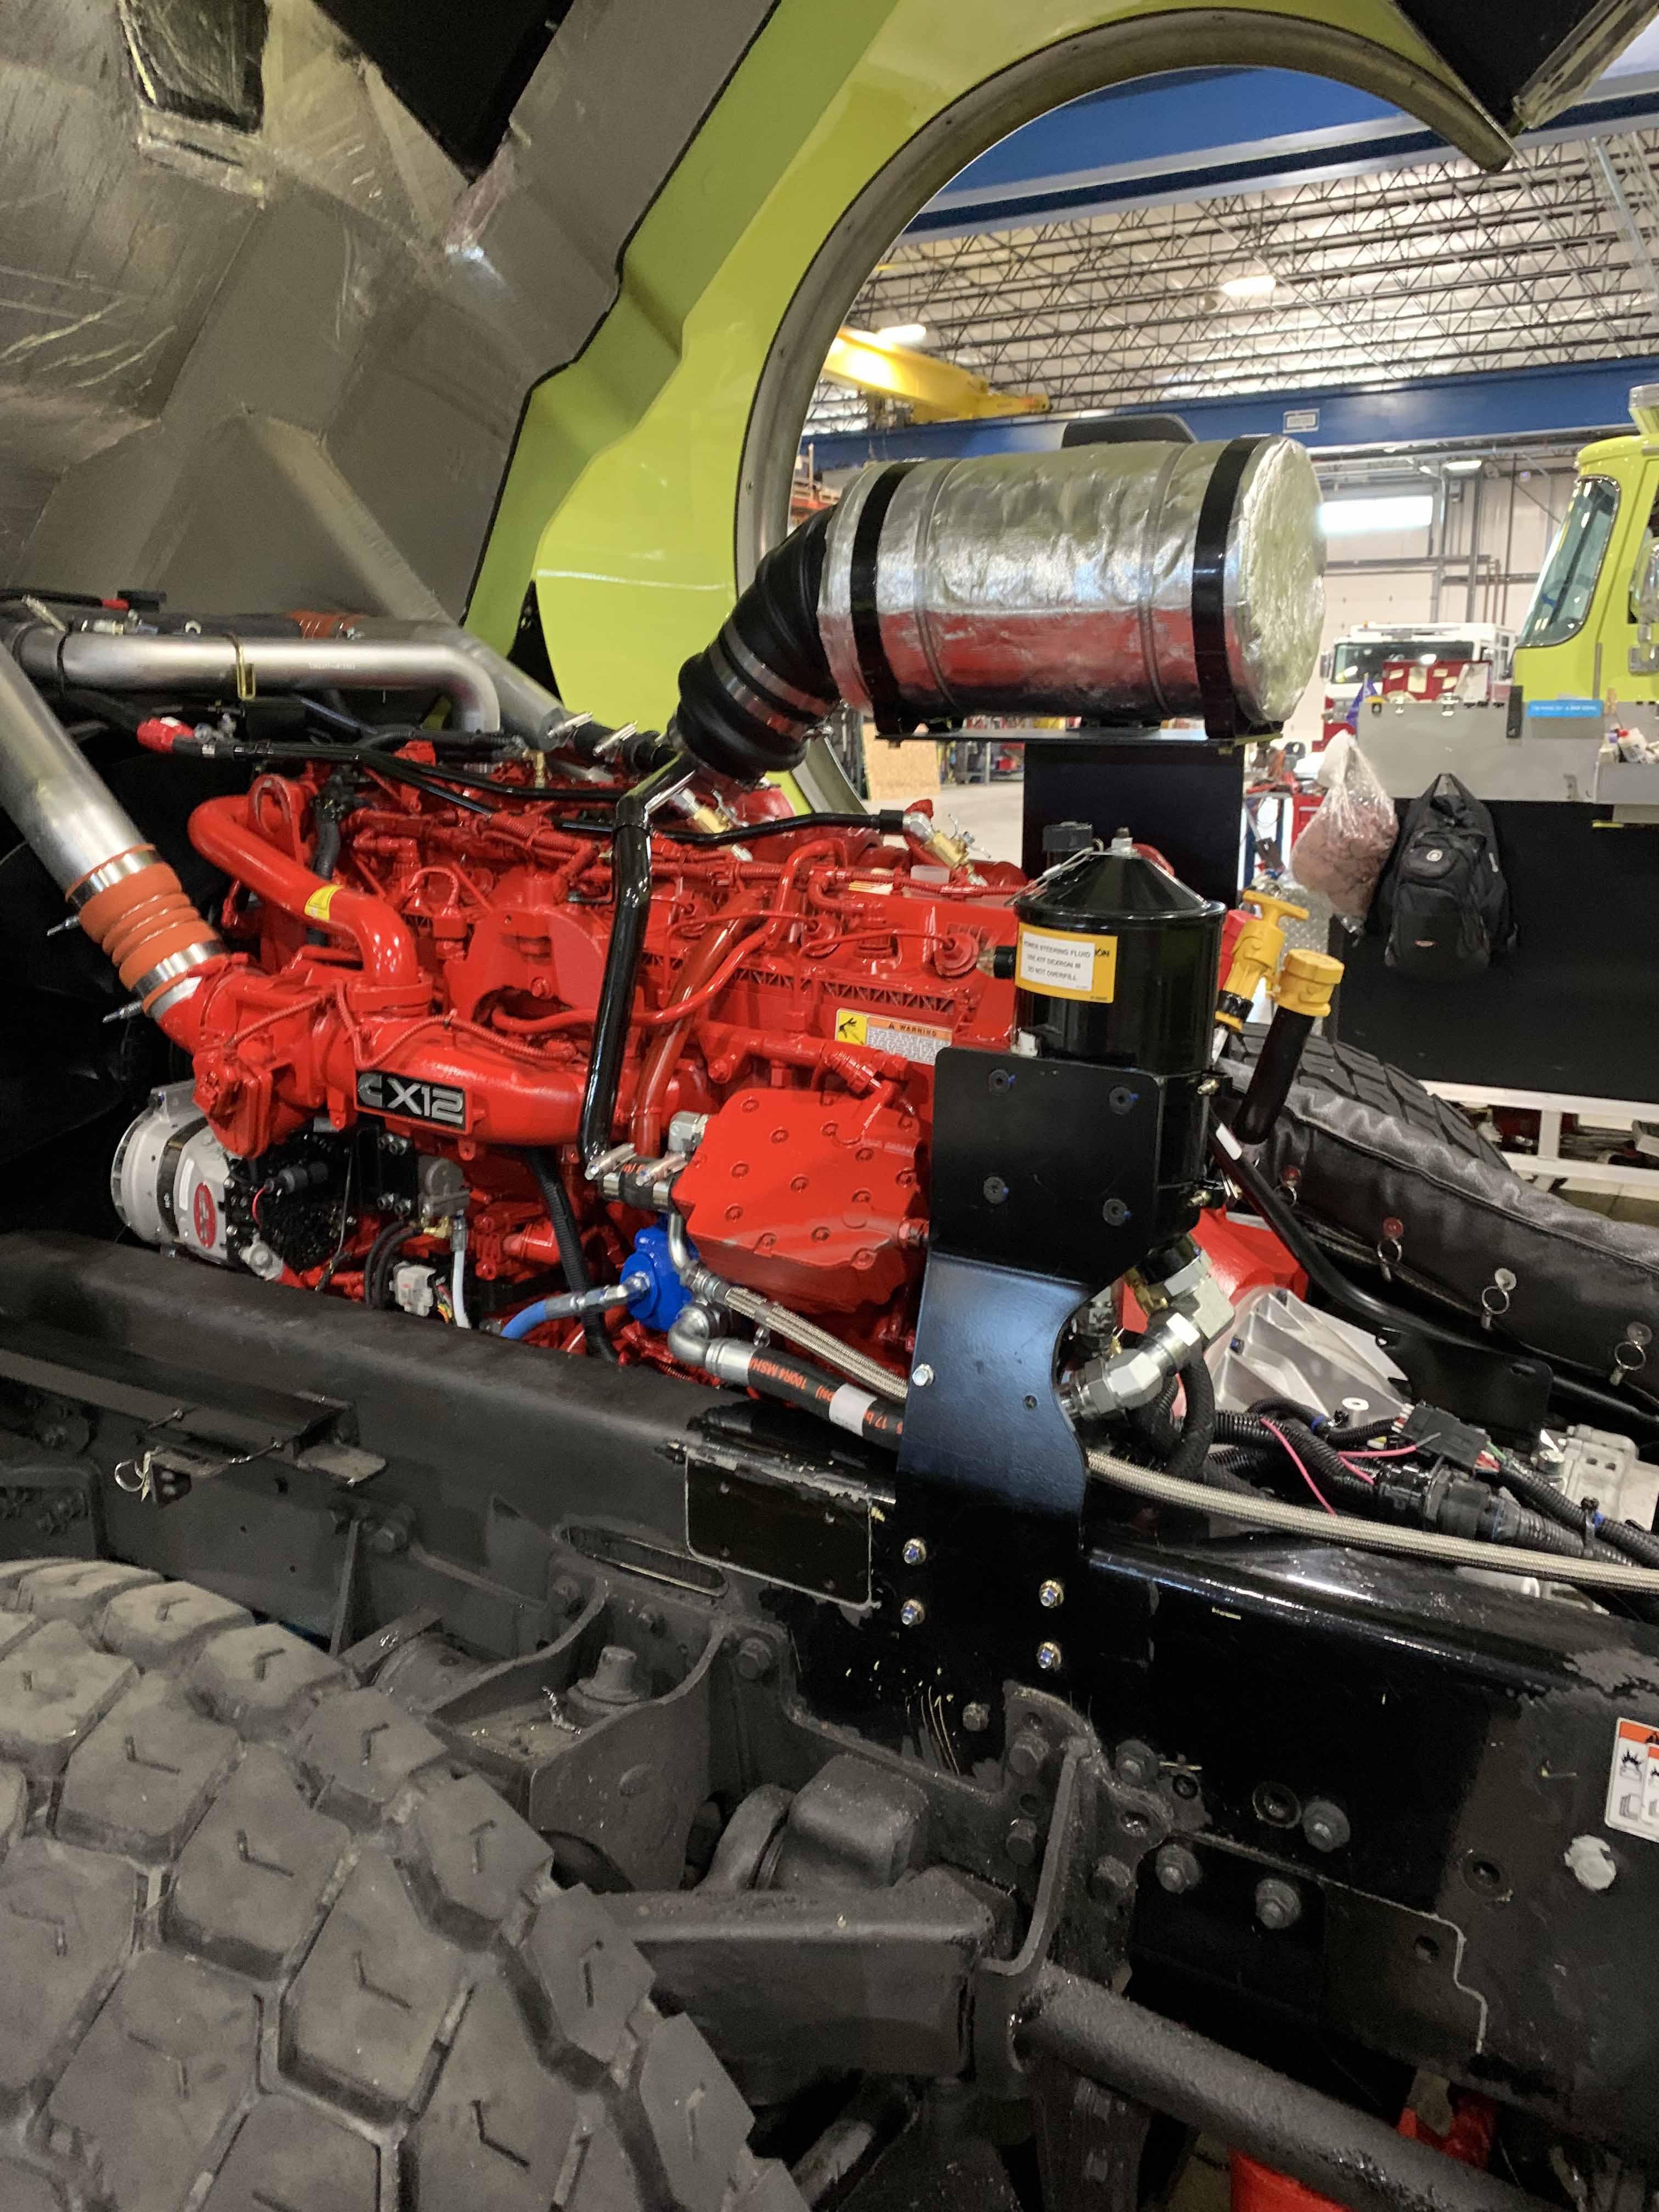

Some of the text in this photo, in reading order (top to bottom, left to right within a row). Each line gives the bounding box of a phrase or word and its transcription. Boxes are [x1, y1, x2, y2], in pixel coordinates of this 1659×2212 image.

[1040, 944, 1069, 956] STEERING
[1070, 949, 1091, 958] FLUID
[1035, 967, 1046, 975] NOT
[1047, 970, 1077, 981] OVERFILL
[900, 1024, 937, 1037] WARNING
